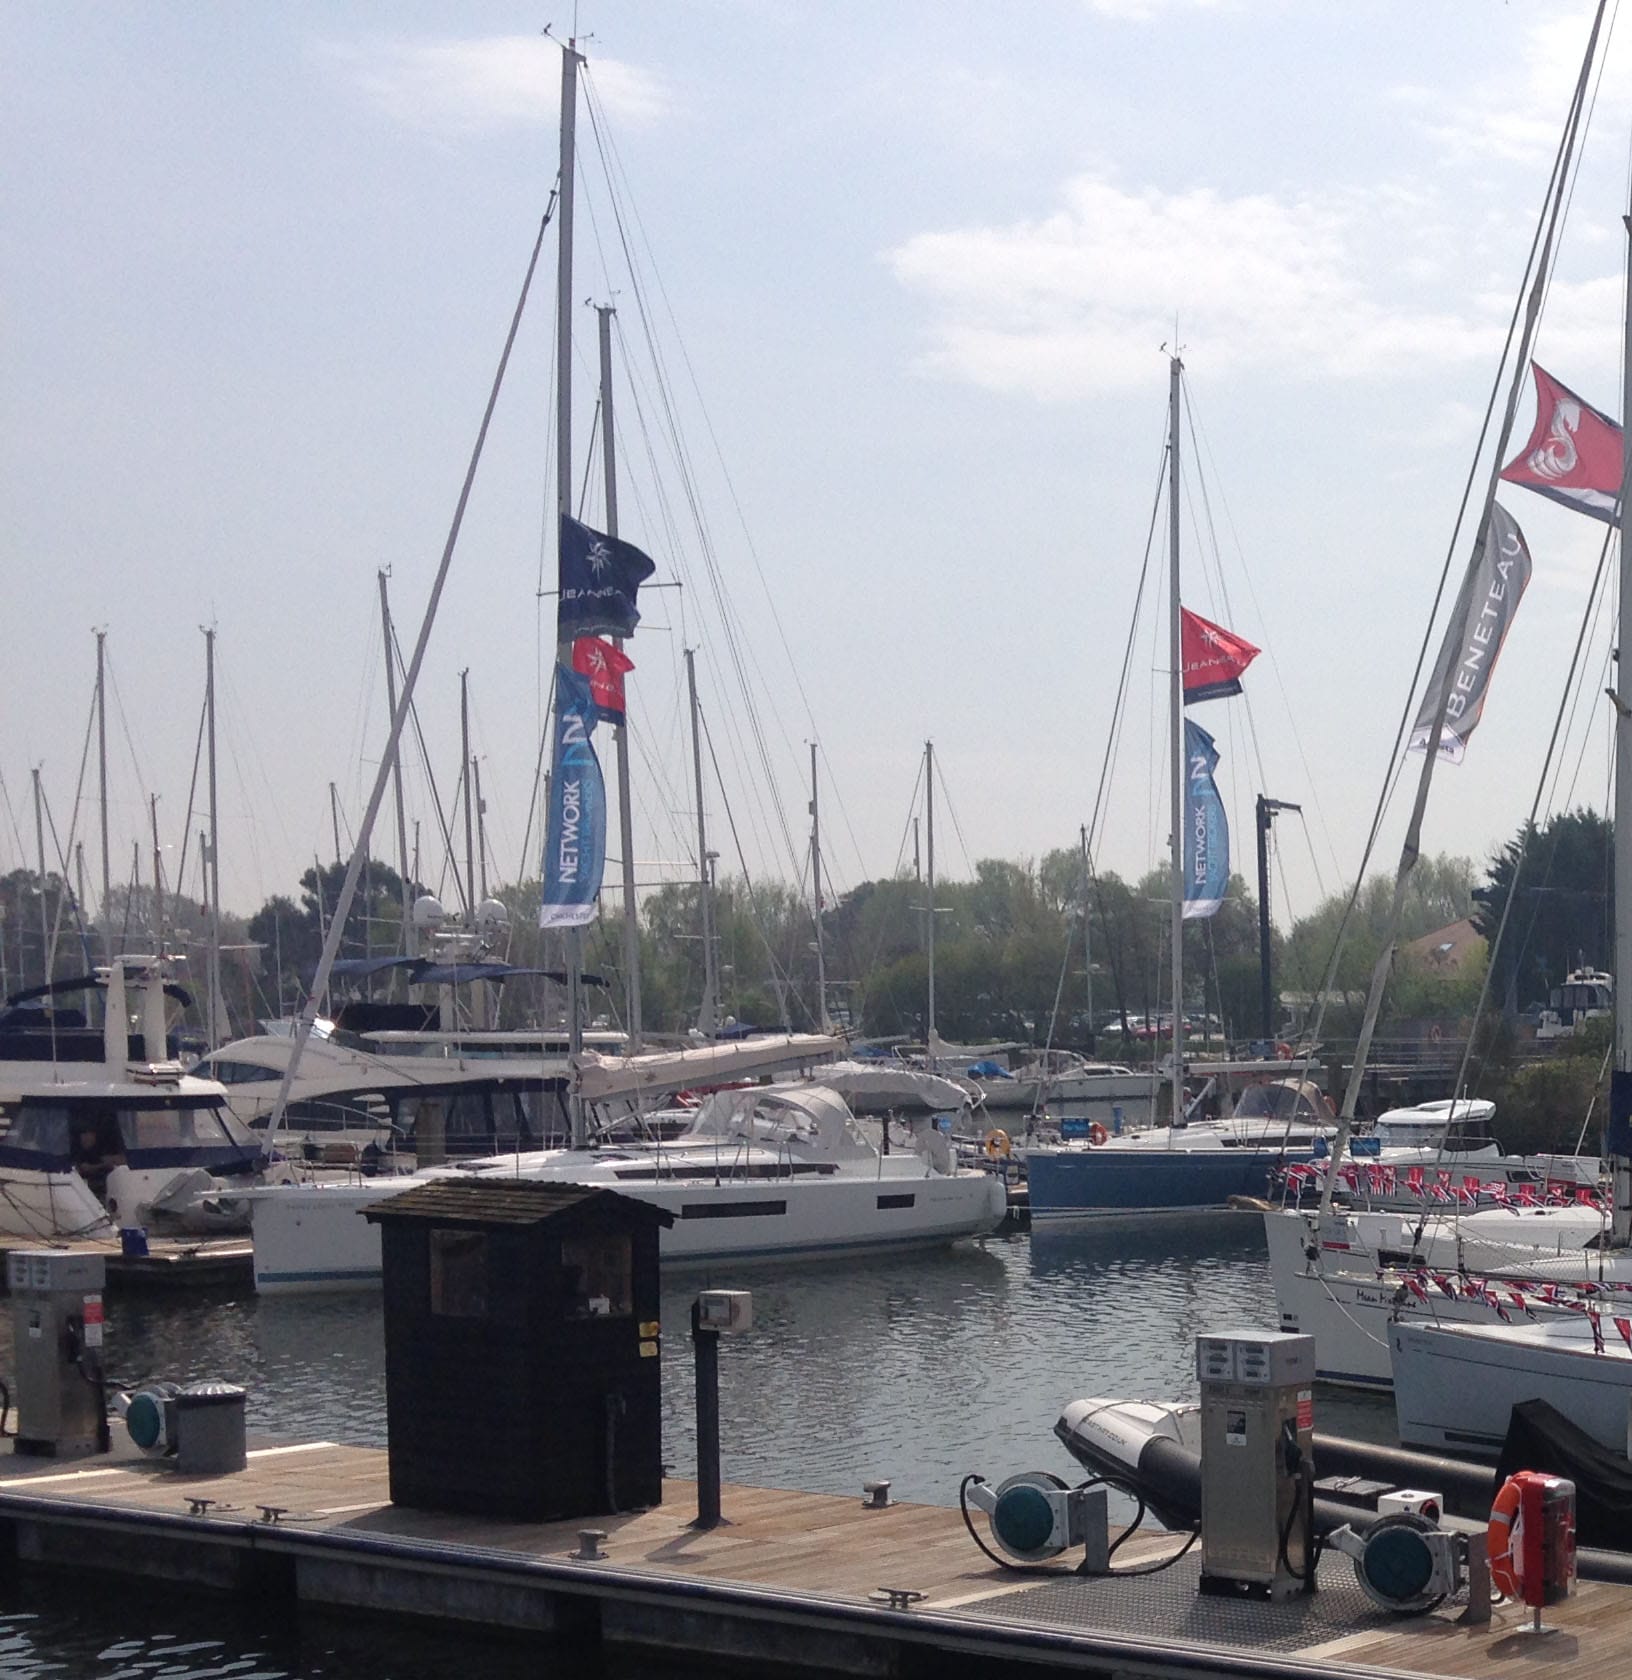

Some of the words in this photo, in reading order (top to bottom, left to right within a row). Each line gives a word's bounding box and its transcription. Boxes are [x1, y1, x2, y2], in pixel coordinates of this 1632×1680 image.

[1446, 532, 1522, 719] BENETEAU
[558, 779, 580, 884] NETWORK
[1194, 804, 1207, 885] NETWORK
